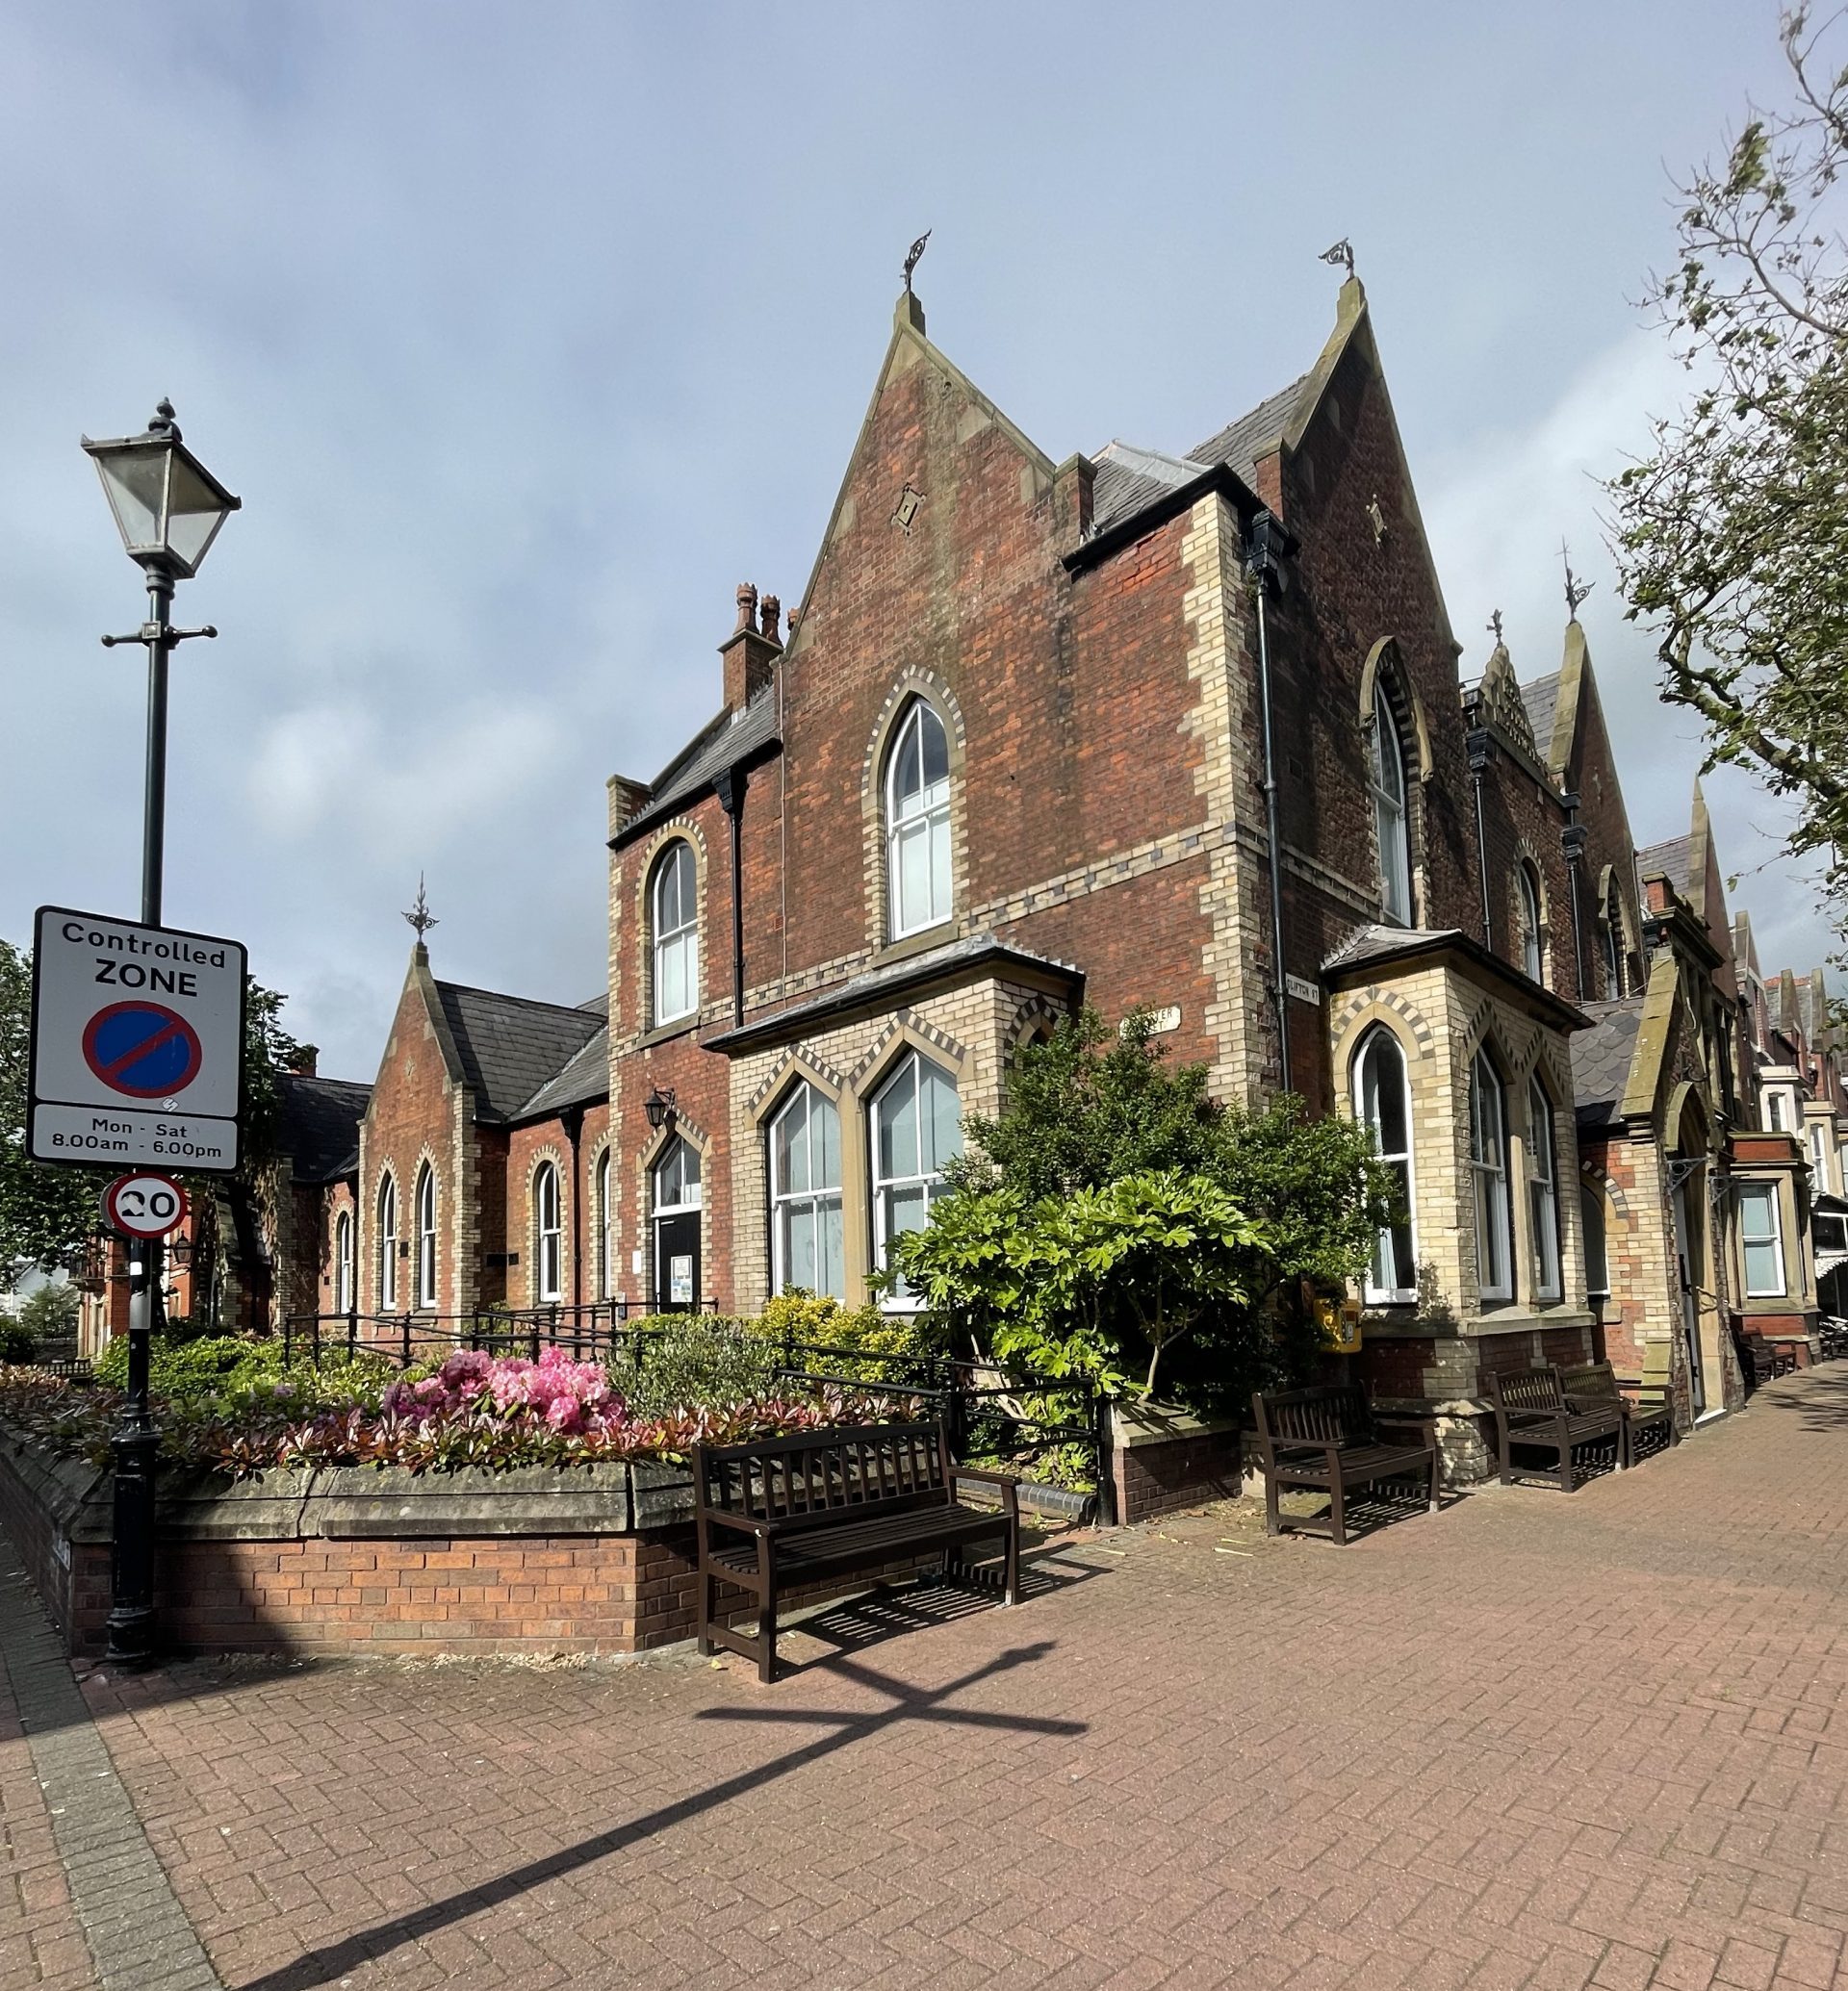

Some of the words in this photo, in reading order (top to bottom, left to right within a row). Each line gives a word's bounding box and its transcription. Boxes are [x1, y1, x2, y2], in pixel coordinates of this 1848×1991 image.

[62, 922, 225, 968] Controlled
[94, 957, 198, 997] ZONE
[91, 1117, 132, 1135] Mon
[155, 1123, 188, 1138] Sat
[52, 1134, 129, 1151] 8.00am
[153, 1141, 221, 1159] 6.00pm
[121, 1190, 175, 1218] 20
